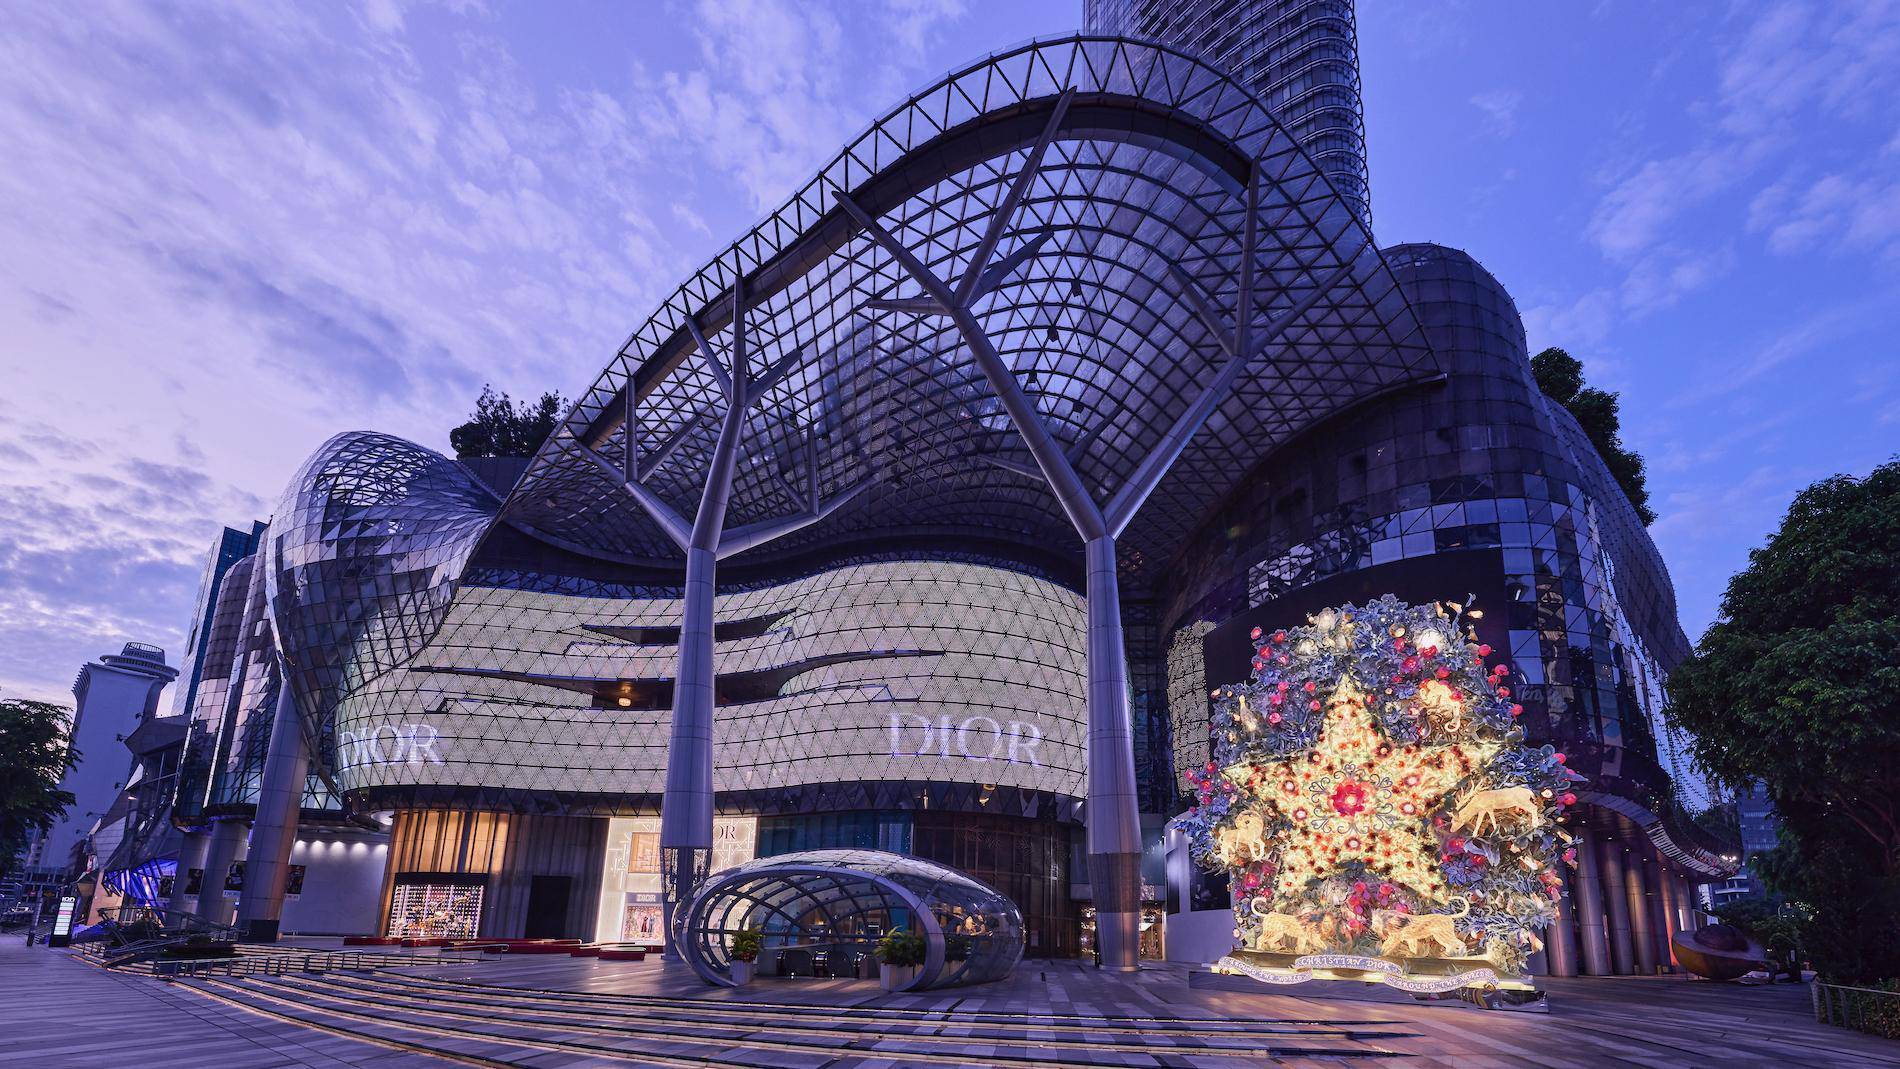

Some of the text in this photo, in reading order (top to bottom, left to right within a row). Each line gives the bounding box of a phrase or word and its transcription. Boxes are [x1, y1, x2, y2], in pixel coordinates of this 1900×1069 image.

[888, 712, 1041, 767] DIOR
[339, 724, 446, 771] DIOR
[637, 894, 656, 902] DIOR
[1301, 957, 1391, 971] CHRISTIAN DIOR
[1440, 978, 1459, 988] THE
